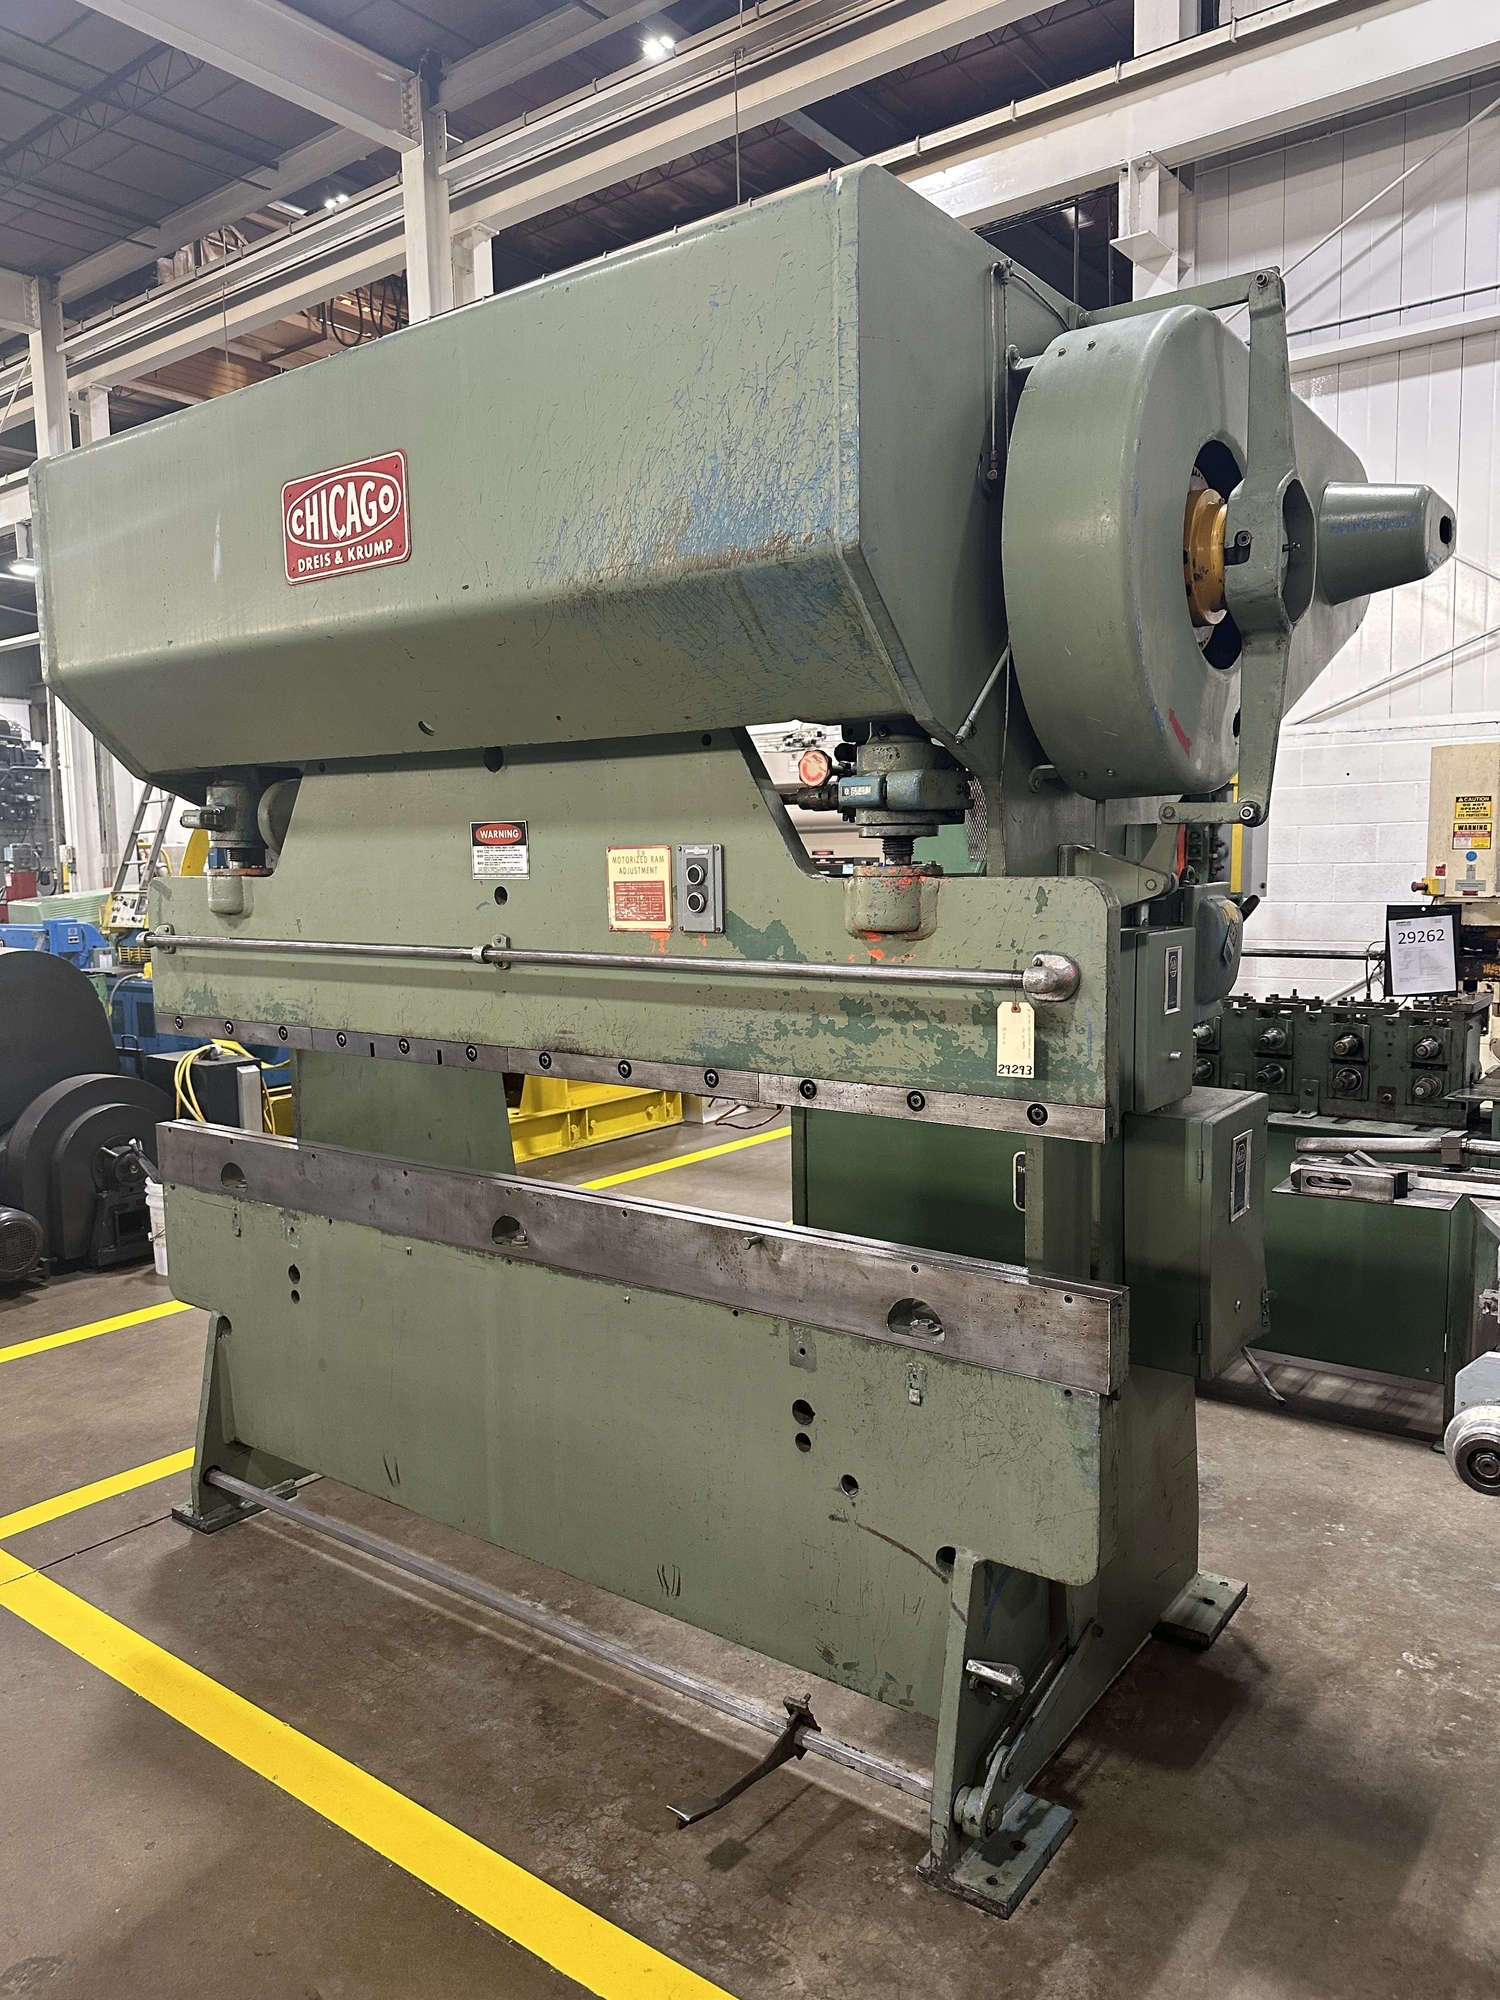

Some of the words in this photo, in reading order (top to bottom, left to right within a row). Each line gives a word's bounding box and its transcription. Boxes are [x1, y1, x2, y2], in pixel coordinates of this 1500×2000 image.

[291, 480, 395, 541] CHICAGO
[297, 552, 332, 573] DREIS
[334, 549, 344, 565] &
[347, 538, 394, 562] KRUMP
[479, 828, 519, 839] WARNING
[611, 855, 648, 865] MOTORIZED
[650, 855, 665, 864] RAM
[618, 866, 659, 875] ADJUSTMENT
[1397, 928, 1446, 945] 29262
[998, 1063, 1033, 1076] 29293
